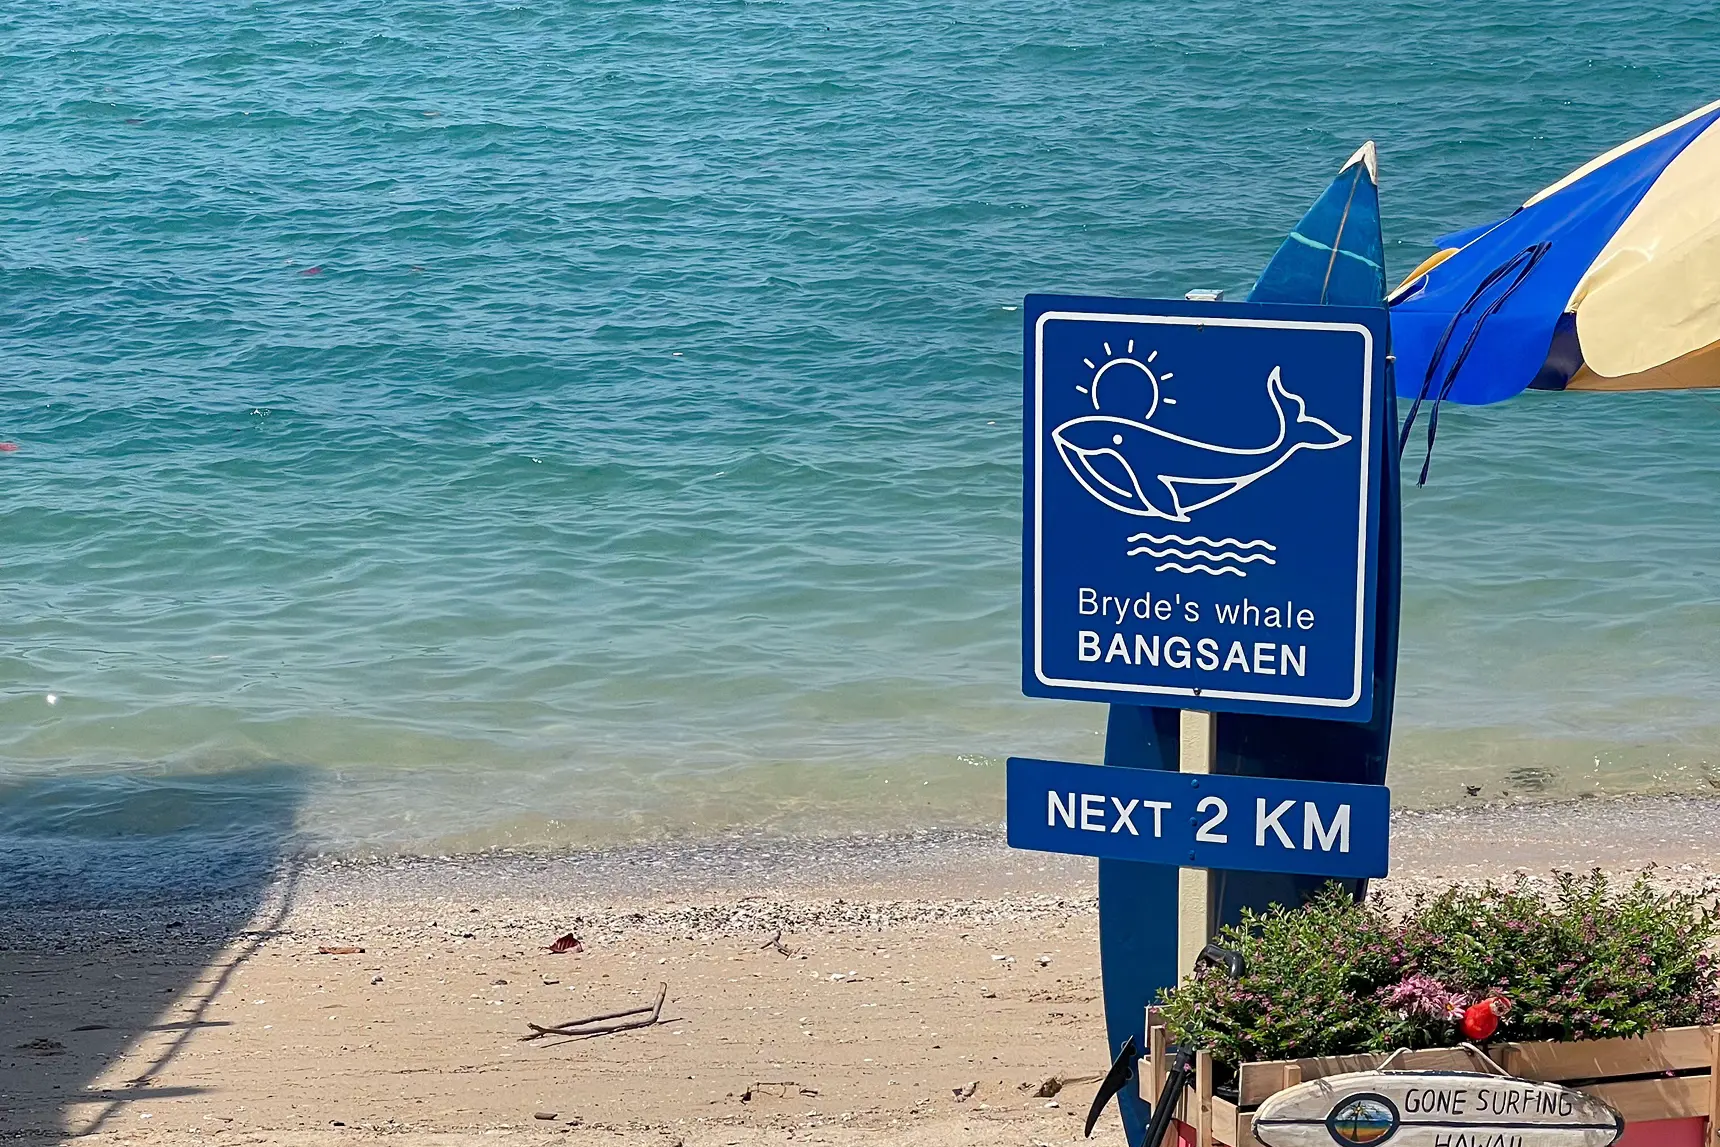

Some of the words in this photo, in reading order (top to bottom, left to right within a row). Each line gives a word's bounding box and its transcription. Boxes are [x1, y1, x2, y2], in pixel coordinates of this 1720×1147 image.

[1078, 587, 1200, 624] Bryde's
[1216, 598, 1315, 630] whale
[1078, 630, 1306, 677] BANGSAEN
[1047, 790, 1172, 838] NEXT
[1195, 796, 1228, 843] 2
[1255, 797, 1351, 853] KM
[1405, 1088, 1467, 1116] GONE
[1475, 1088, 1573, 1117] SURFING
